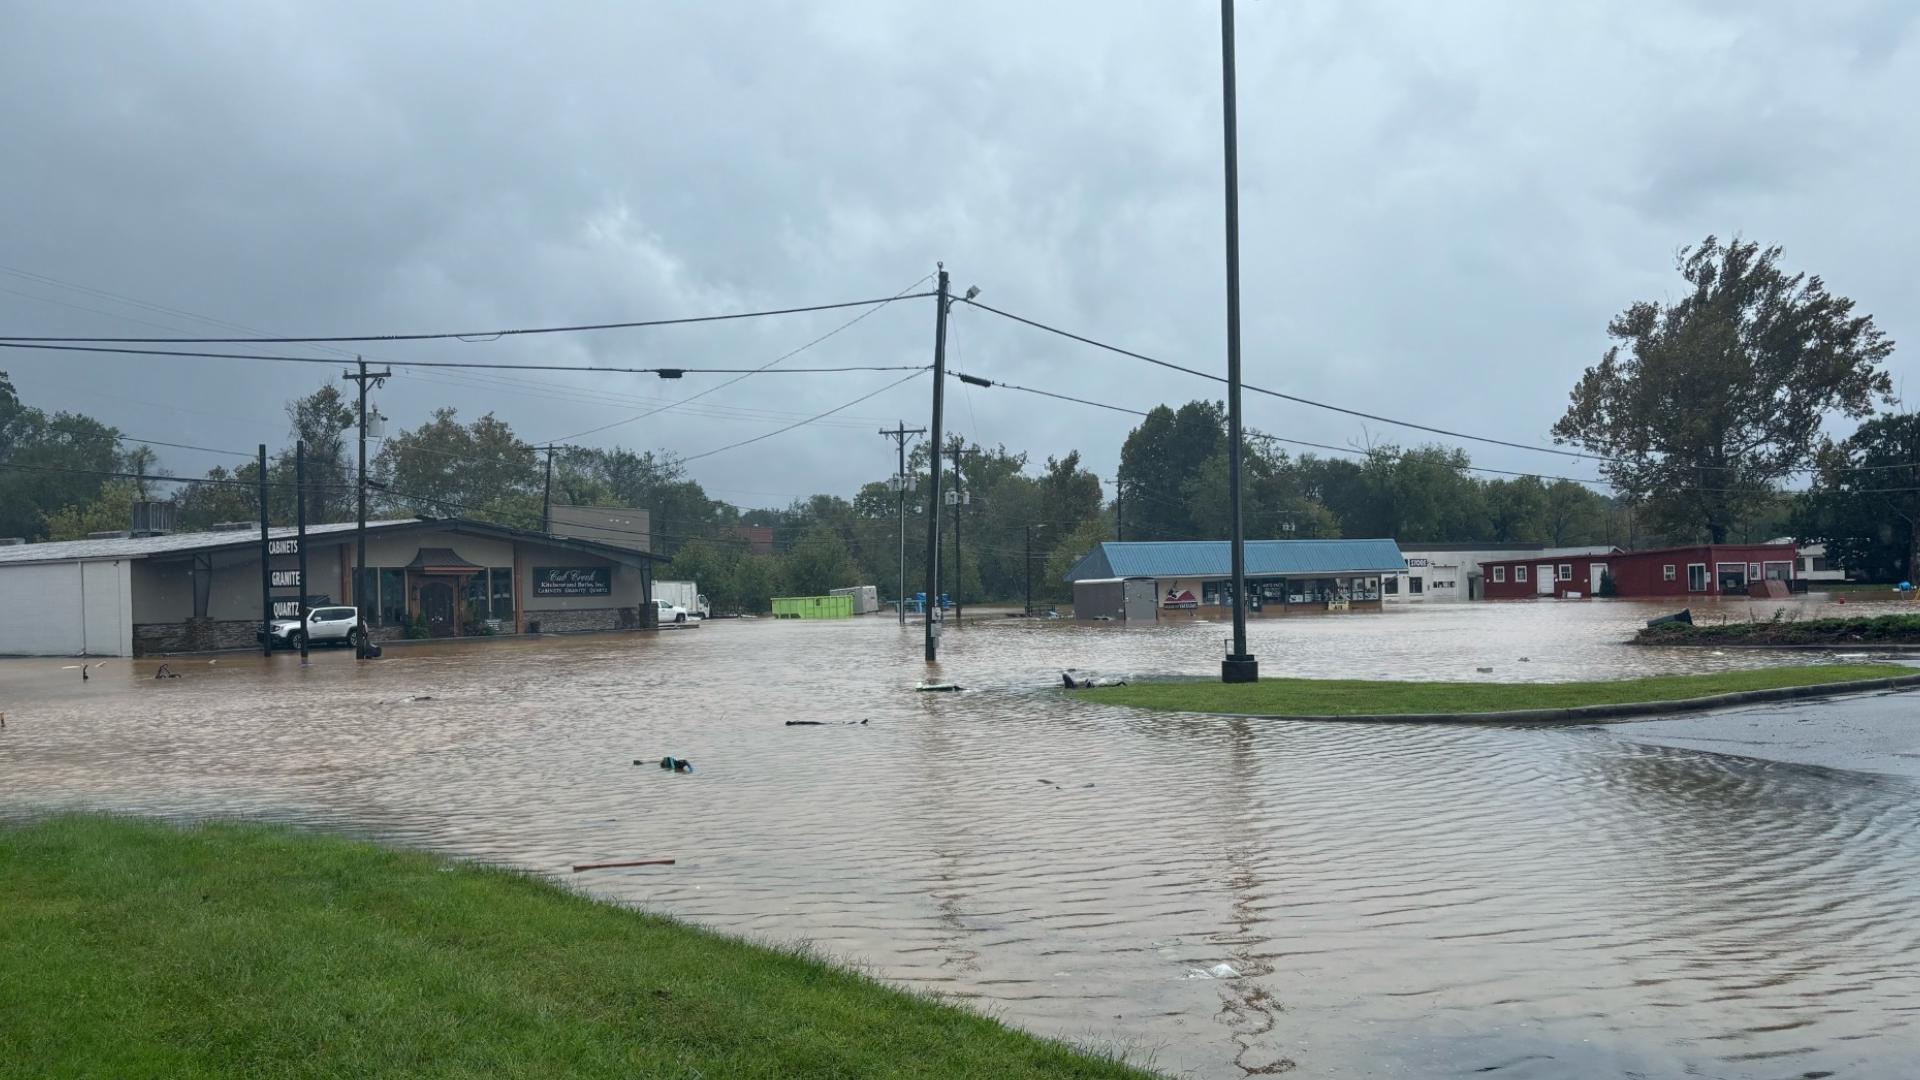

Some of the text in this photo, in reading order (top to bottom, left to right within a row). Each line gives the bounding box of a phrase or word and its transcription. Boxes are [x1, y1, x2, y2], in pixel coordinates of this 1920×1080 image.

[268, 540, 298, 554] CABINETS
[271, 571, 301, 586] GRANITE
[273, 602, 300, 618] QUARTZ
